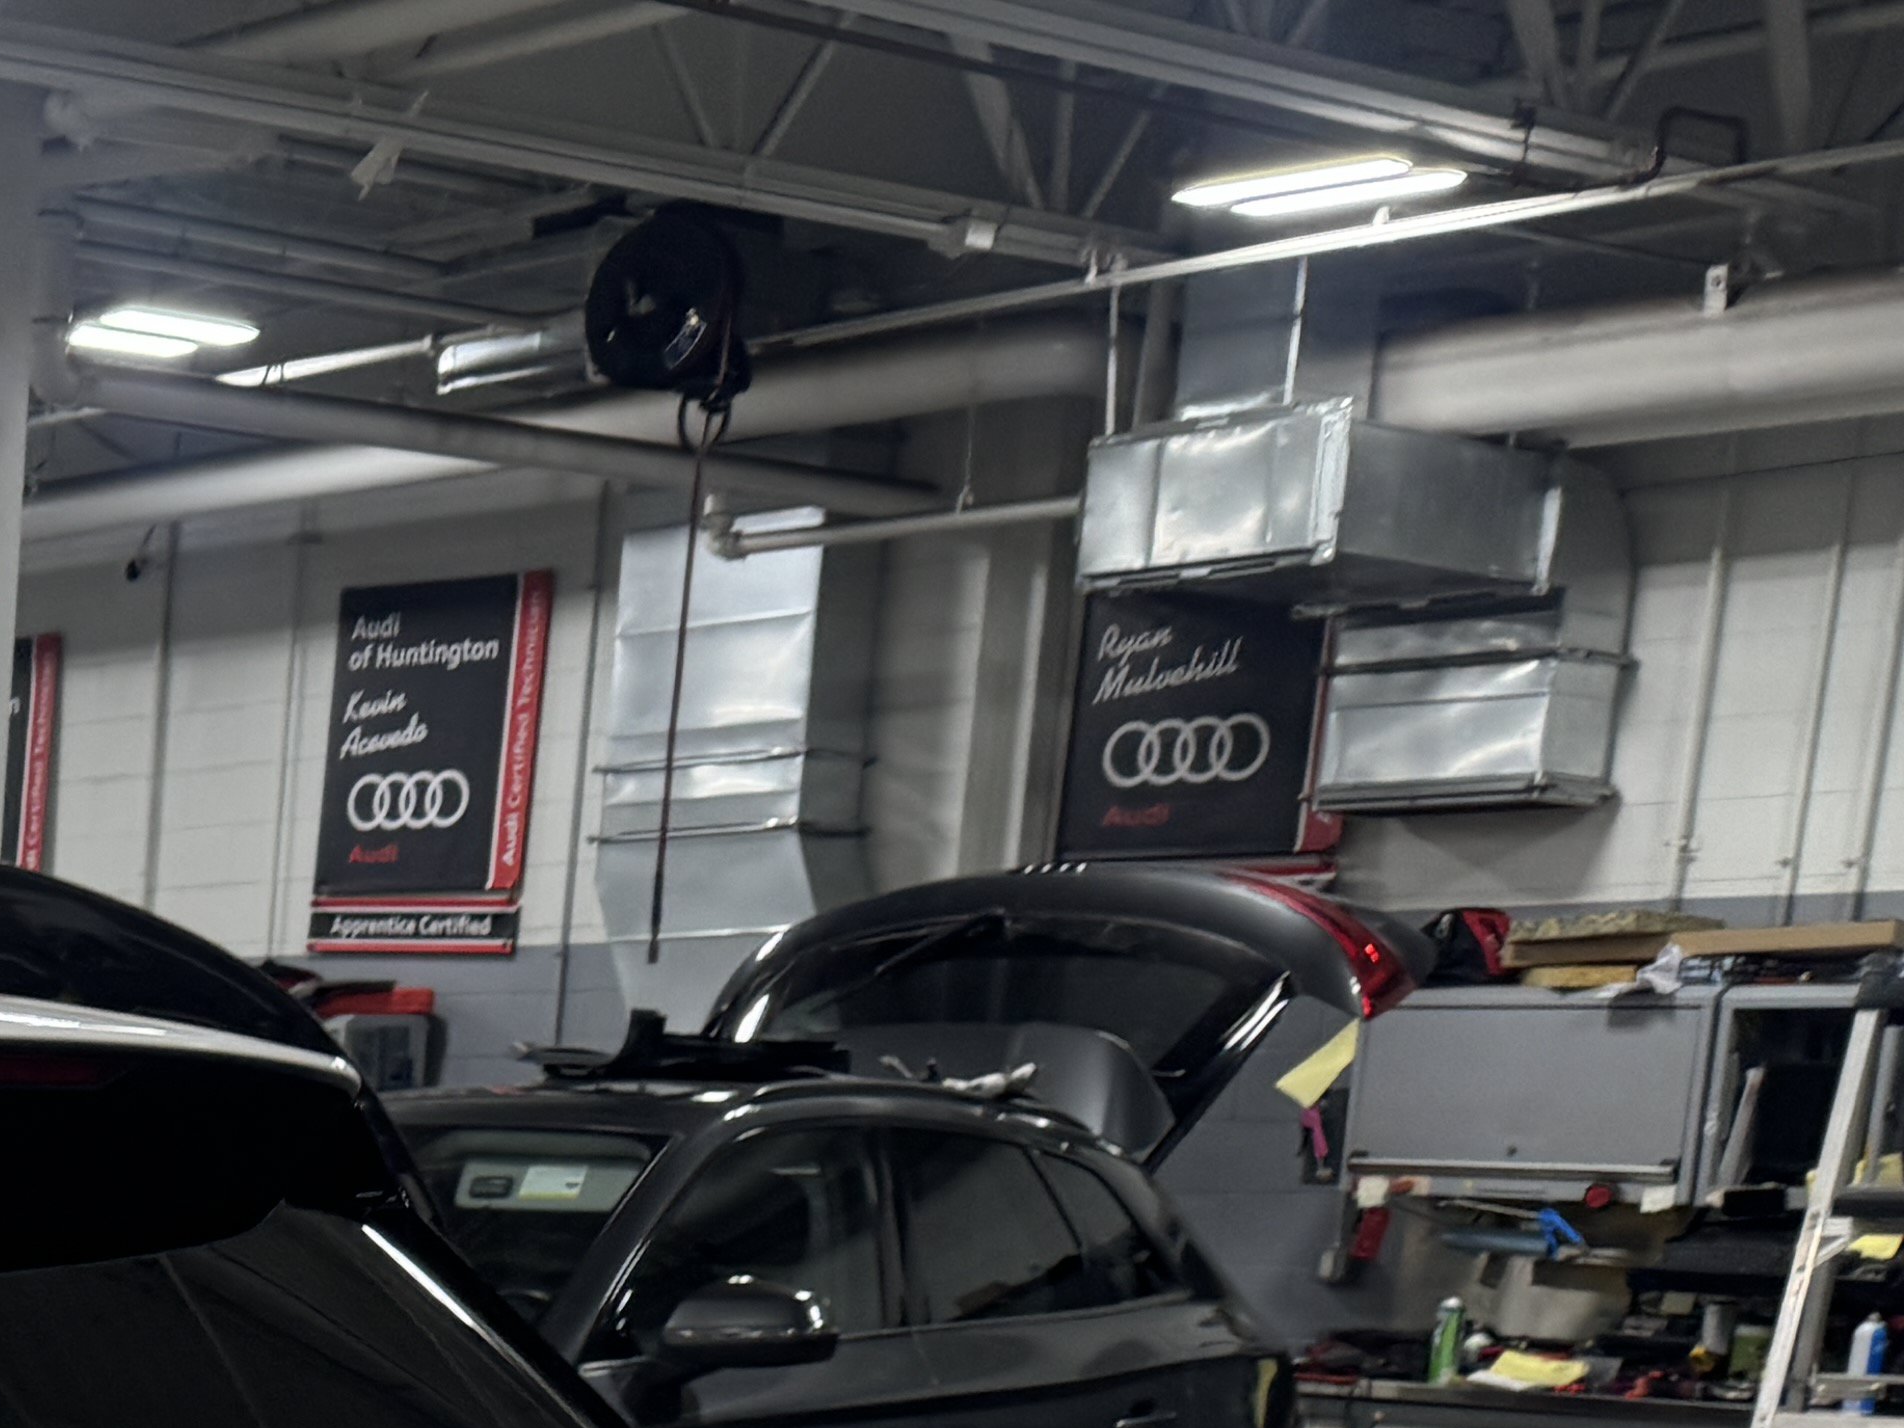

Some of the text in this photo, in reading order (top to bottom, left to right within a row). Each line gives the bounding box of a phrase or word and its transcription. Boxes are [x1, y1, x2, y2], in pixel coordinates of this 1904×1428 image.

[351, 612, 401, 640] Audi
[348, 637, 500, 671] of Huntington
[1098, 624, 1173, 666] Ryan
[342, 689, 408, 724] Kevin
[339, 712, 429, 760] Acevedo
[506, 714, 531, 807] Certified
[349, 843, 399, 864] Audi
[502, 811, 519, 867] Audi
[330, 913, 492, 939] Apprentice Certified
